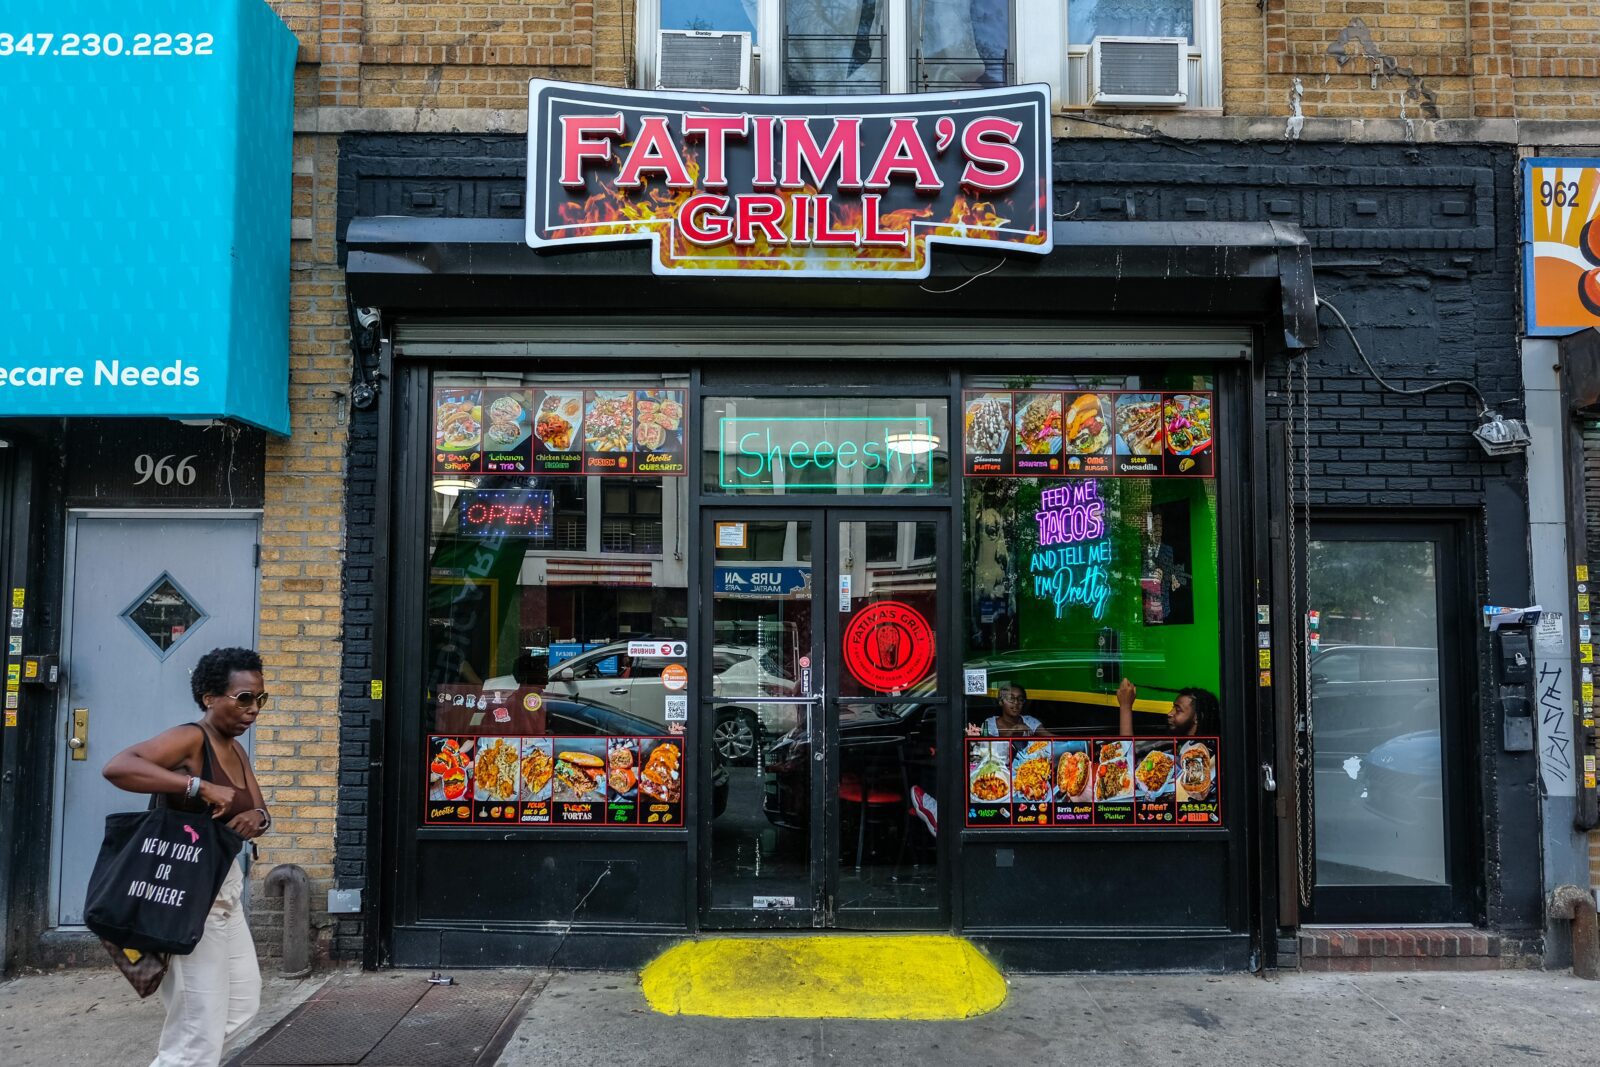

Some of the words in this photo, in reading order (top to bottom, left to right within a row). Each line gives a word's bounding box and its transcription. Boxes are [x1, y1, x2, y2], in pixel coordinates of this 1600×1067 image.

[0, 33, 214, 56] 347.230.2232
[559, 112, 1025, 191] FATIMA'S
[1540, 180, 1579, 208] 962
[677, 194, 909, 247] GRILL
[95, 360, 200, 386] Needs
[133, 454, 197, 486] 966
[489, 453, 524, 461] Lebanon
[1120, 463, 1158, 471] Quesadilla
[1041, 486, 1070, 511] FEED
[1073, 480, 1094, 506] ME
[467, 504, 544, 525] OPEN
[1035, 502, 1101, 546] TACOS
[1030, 550, 1057, 572] AND
[1057, 546, 1086, 567] TELL
[1088, 542, 1109, 565] ME
[1052, 566, 1107, 619] Pretty
[562, 812, 592, 820] TORTAS
[141, 838, 170, 857] NEW
[170, 843, 202, 863] YORK
[155, 863, 172, 880] OR
[128, 880, 186, 907] NOWHERE
